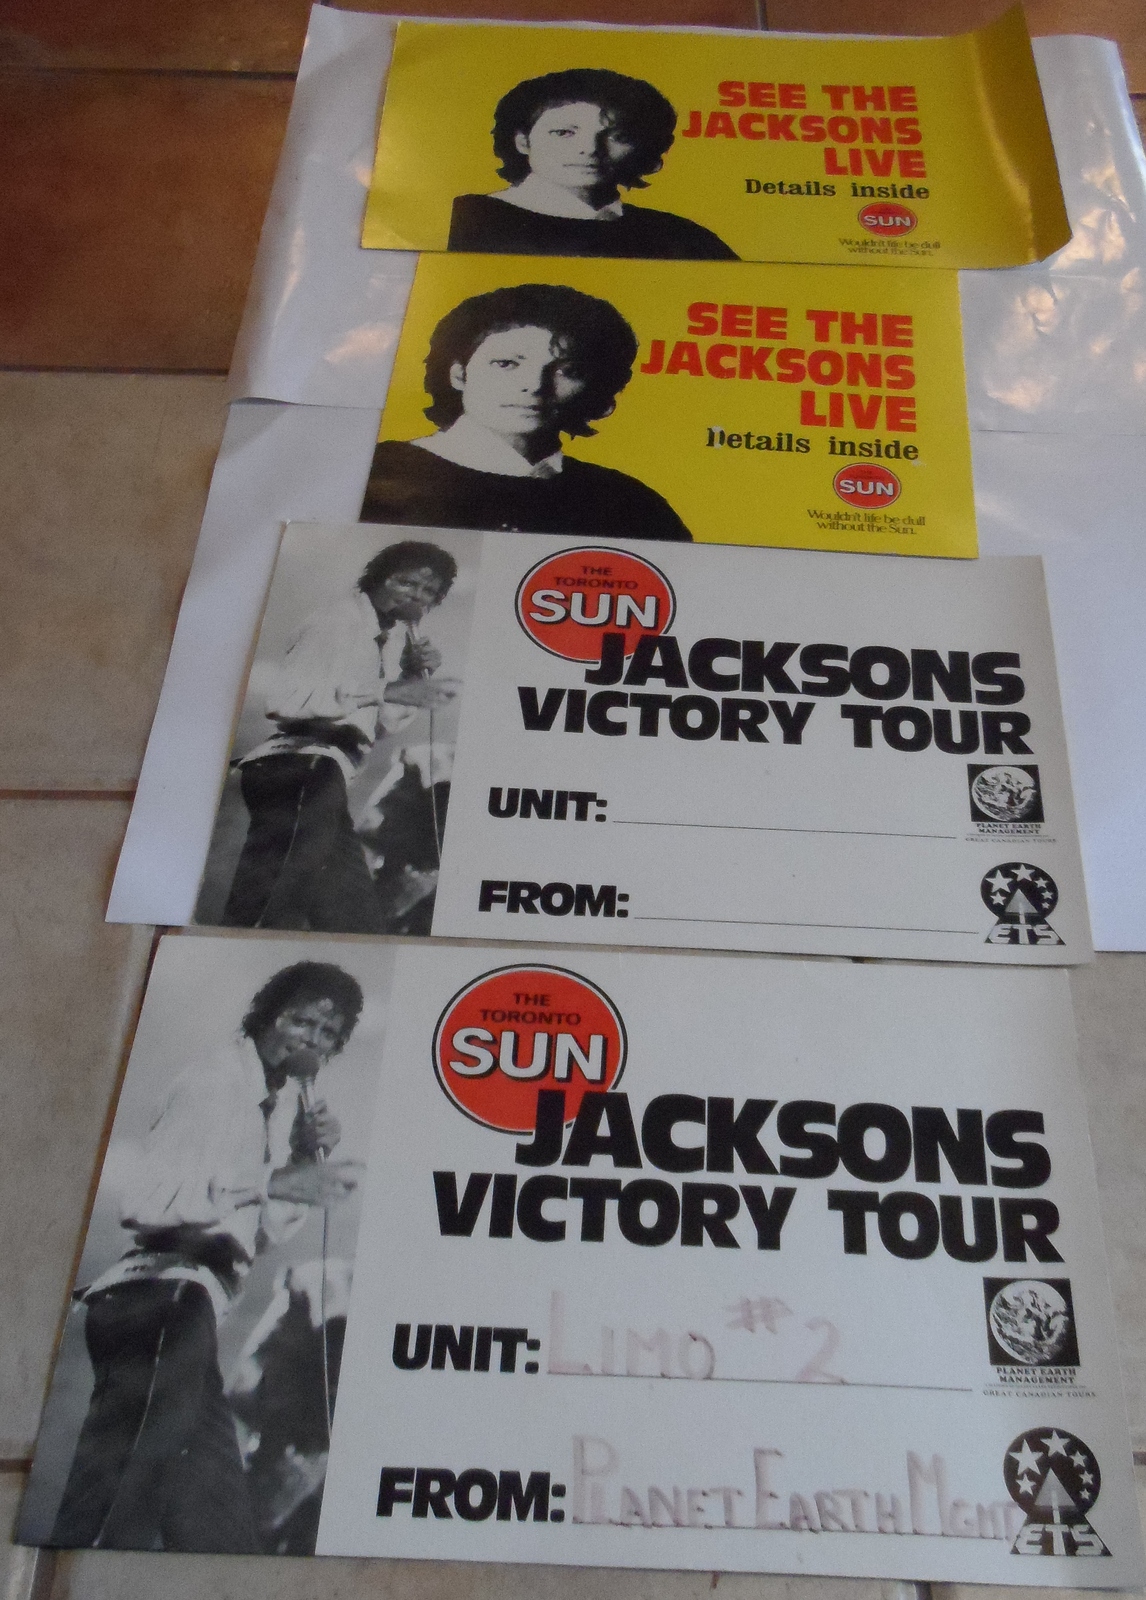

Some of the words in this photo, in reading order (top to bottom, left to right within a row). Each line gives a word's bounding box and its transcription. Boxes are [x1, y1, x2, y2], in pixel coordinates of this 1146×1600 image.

[718, 80, 807, 109] SEE
[821, 85, 918, 112] THE
[682, 110, 922, 145] JACKSONS
[823, 147, 927, 178] LIVE
[745, 178, 836, 196] Details
[851, 182, 930, 199] inside
[863, 215, 911, 227] SUN
[687, 302, 788, 340] SEE
[806, 310, 914, 348] THE
[640, 340, 916, 390] JACKSONS
[800, 390, 917, 433] LIVE
[706, 427, 811, 453] Details
[828, 436, 919, 460] inside
[839, 479, 895, 496] SUN
[807, 509, 861, 522] Wouldn't
[864, 513, 881, 524] life
[884, 513, 900, 524] be
[902, 515, 926, 526] dull
[817, 520, 865, 532] without
[867, 522, 887, 533] the
[553, 576, 639, 590] TORONTO
[581, 565, 613, 576] THE
[529, 589, 660, 629] SUN
[584, 632, 1026, 706] JACKSONS
[517, 686, 816, 745] VICTORY
[841, 703, 1035, 755] TOUR
[487, 787, 608, 823] UNIT:
[478, 880, 630, 918] FROM:
[985, 923, 1060, 944] ETS
[513, 992, 551, 1006] THE
[480, 1008, 581, 1026] TORONTO
[449, 1027, 608, 1085] SUN
[515, 1089, 1052, 1189] JACKSONS
[432, 1170, 797, 1251] VICTORY
[827, 1189, 1065, 1263] TOUR
[391, 1323, 541, 1374] UNIT:
[996, 1366, 1037, 1376] PLANET
[1040, 1367, 1077, 1376] EARTH
[999, 1375, 1075, 1384] MANAGEMENT
[983, 1389, 1012, 1398] GREAT
[1015, 1390, 1063, 1398] CANADIAN
[375, 1466, 566, 1525] FROM:
[753, 1447, 901, 1535] EARTH
[1013, 1523, 1105, 1556] ETS
